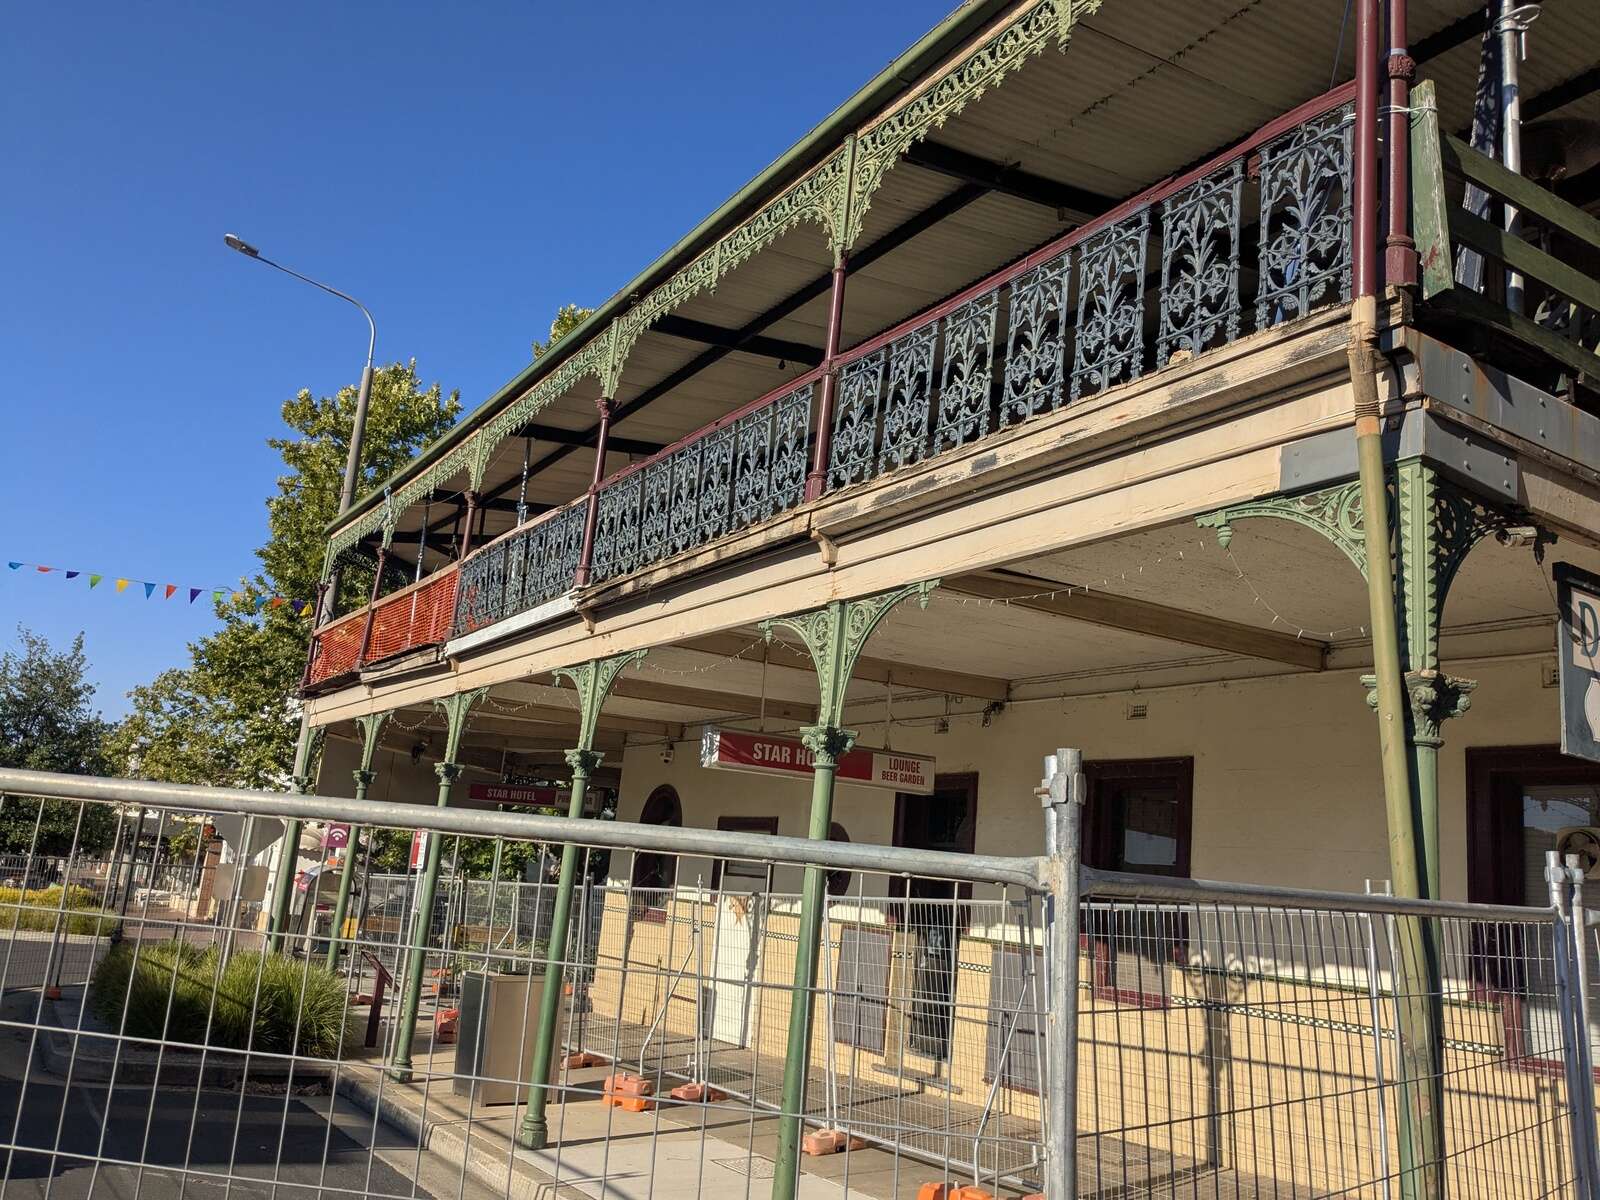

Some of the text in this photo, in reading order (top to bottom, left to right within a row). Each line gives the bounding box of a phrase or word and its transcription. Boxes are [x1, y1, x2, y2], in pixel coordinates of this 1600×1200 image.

[753, 742, 791, 763] STAR
[889, 757, 921, 773] LOUNGE
[881, 770, 925, 786] BEER GARDEN
[487, 788, 537, 801] STAR HOTEL
